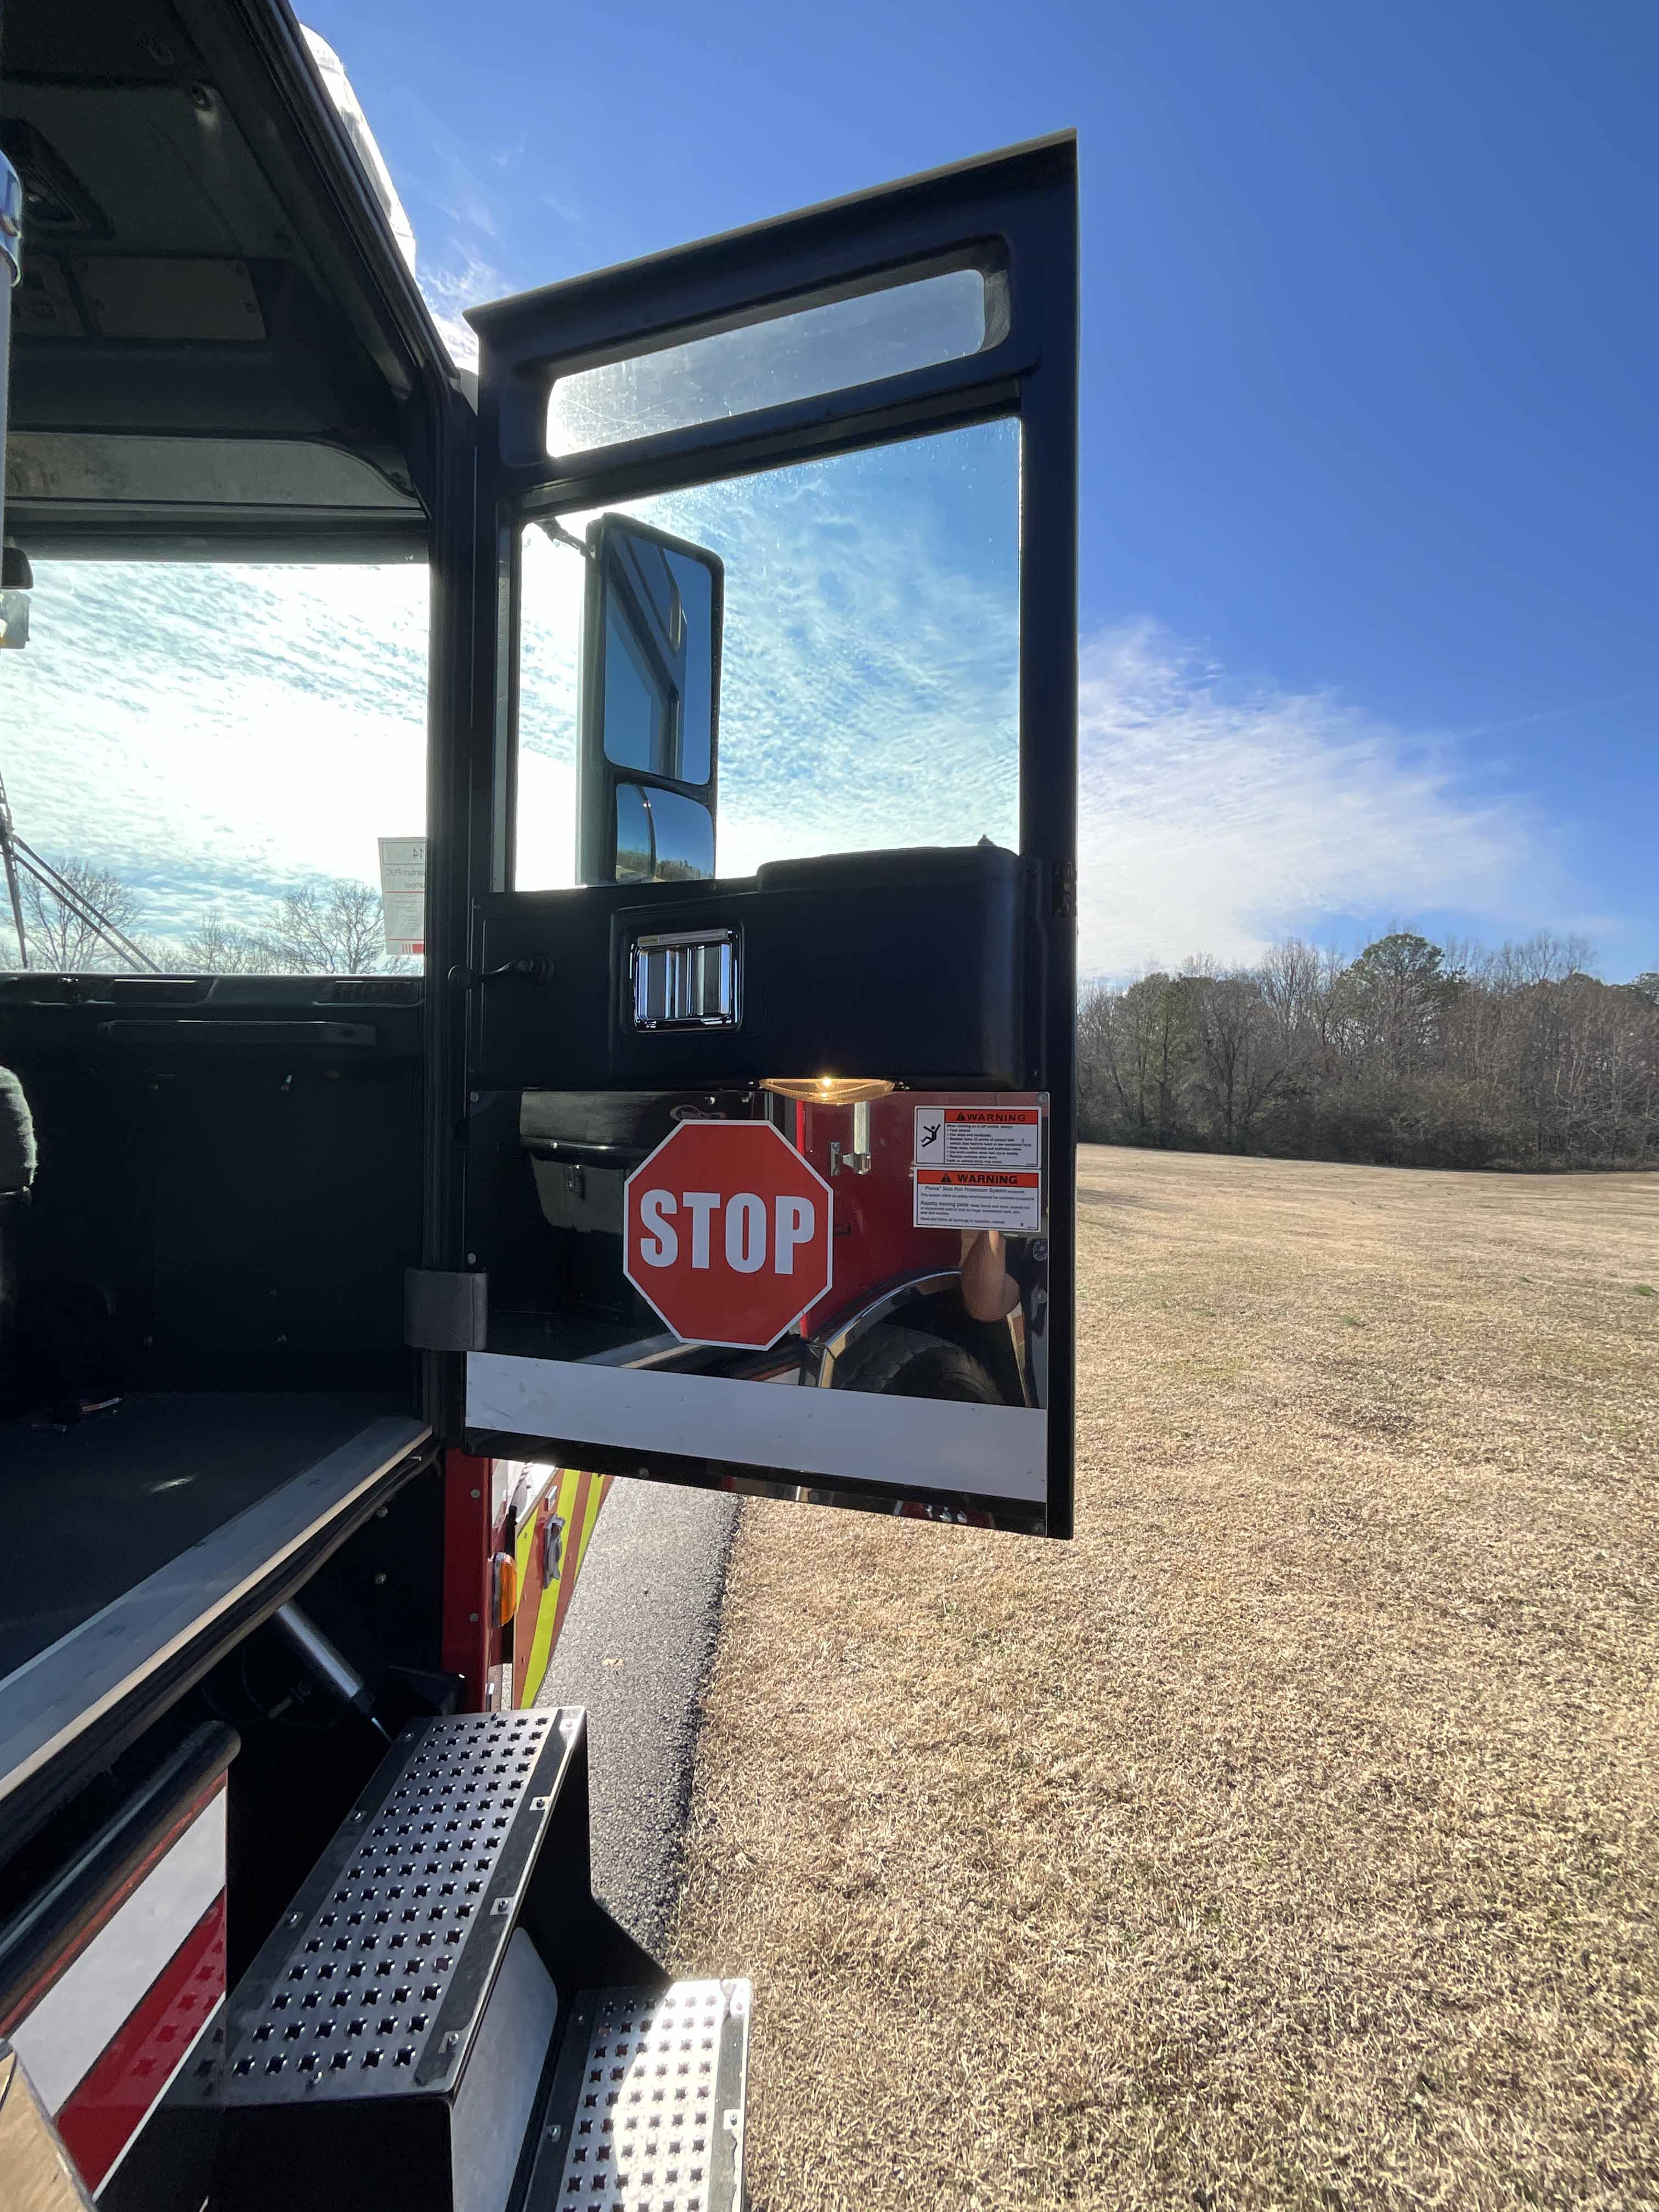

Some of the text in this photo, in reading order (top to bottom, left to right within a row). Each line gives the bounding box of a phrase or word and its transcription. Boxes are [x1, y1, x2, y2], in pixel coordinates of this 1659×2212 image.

[967, 1113, 1026, 1122] WARNING
[957, 1173, 1018, 1185] WARNING
[640, 1189, 816, 1275] STOP
